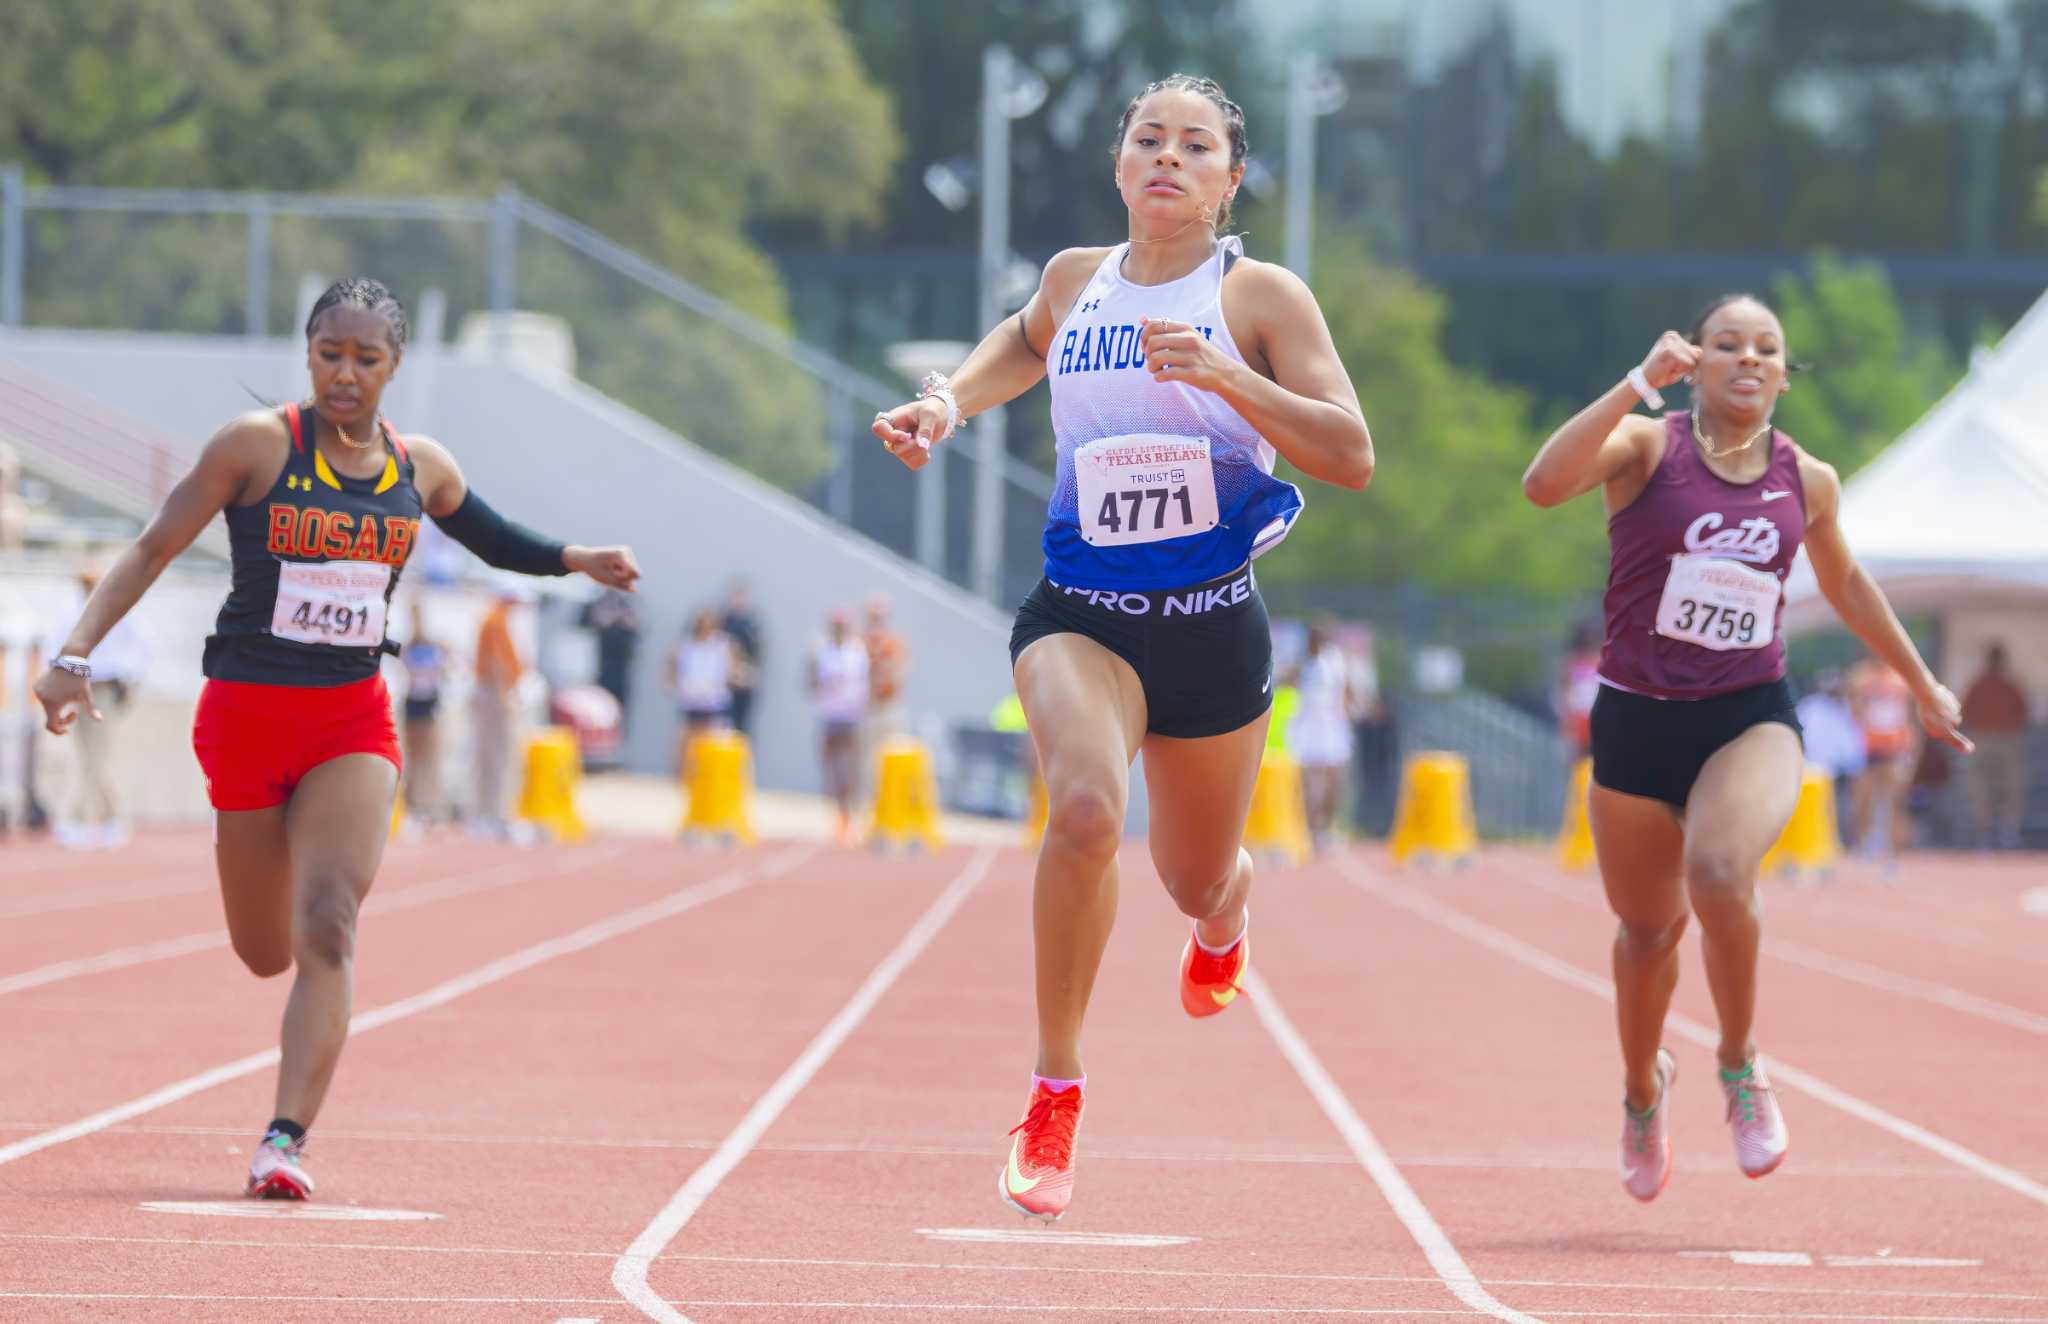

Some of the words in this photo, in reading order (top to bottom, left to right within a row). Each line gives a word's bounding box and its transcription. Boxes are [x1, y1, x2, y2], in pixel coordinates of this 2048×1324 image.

[1105, 453, 1152, 467] TEXAS
[1154, 449, 1207, 463] RELAYS
[1130, 472, 1169, 484] TRUIST
[1098, 485, 1193, 533] 4771
[1684, 512, 1780, 564] Cats
[1163, 575, 1250, 617] NIKE
[291, 601, 369, 637] 4491
[1674, 599, 1756, 643] 3759
